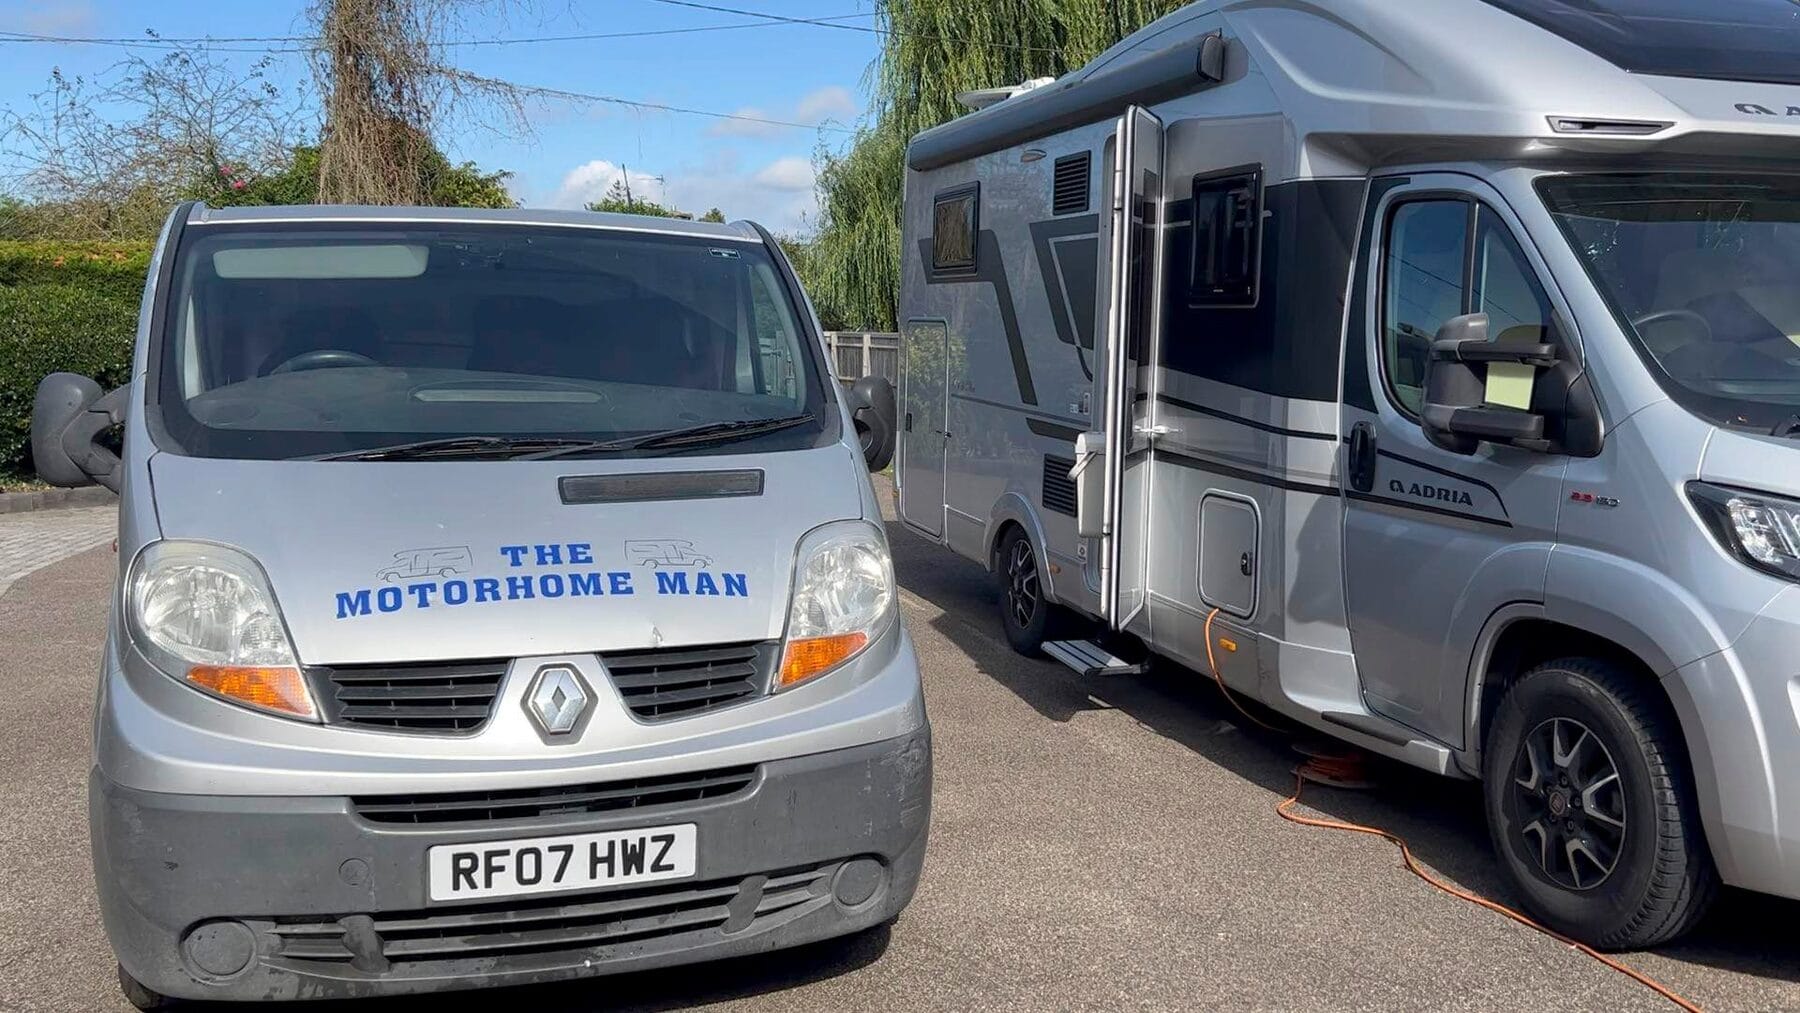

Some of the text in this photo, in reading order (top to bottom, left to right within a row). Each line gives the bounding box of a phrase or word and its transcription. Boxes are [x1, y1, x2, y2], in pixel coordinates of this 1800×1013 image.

[1408, 483, 1473, 506] ADRIA
[501, 543, 593, 567] THE
[336, 572, 748, 618] MOTORHOME MAN
[451, 834, 675, 891] RF07 HWZ
